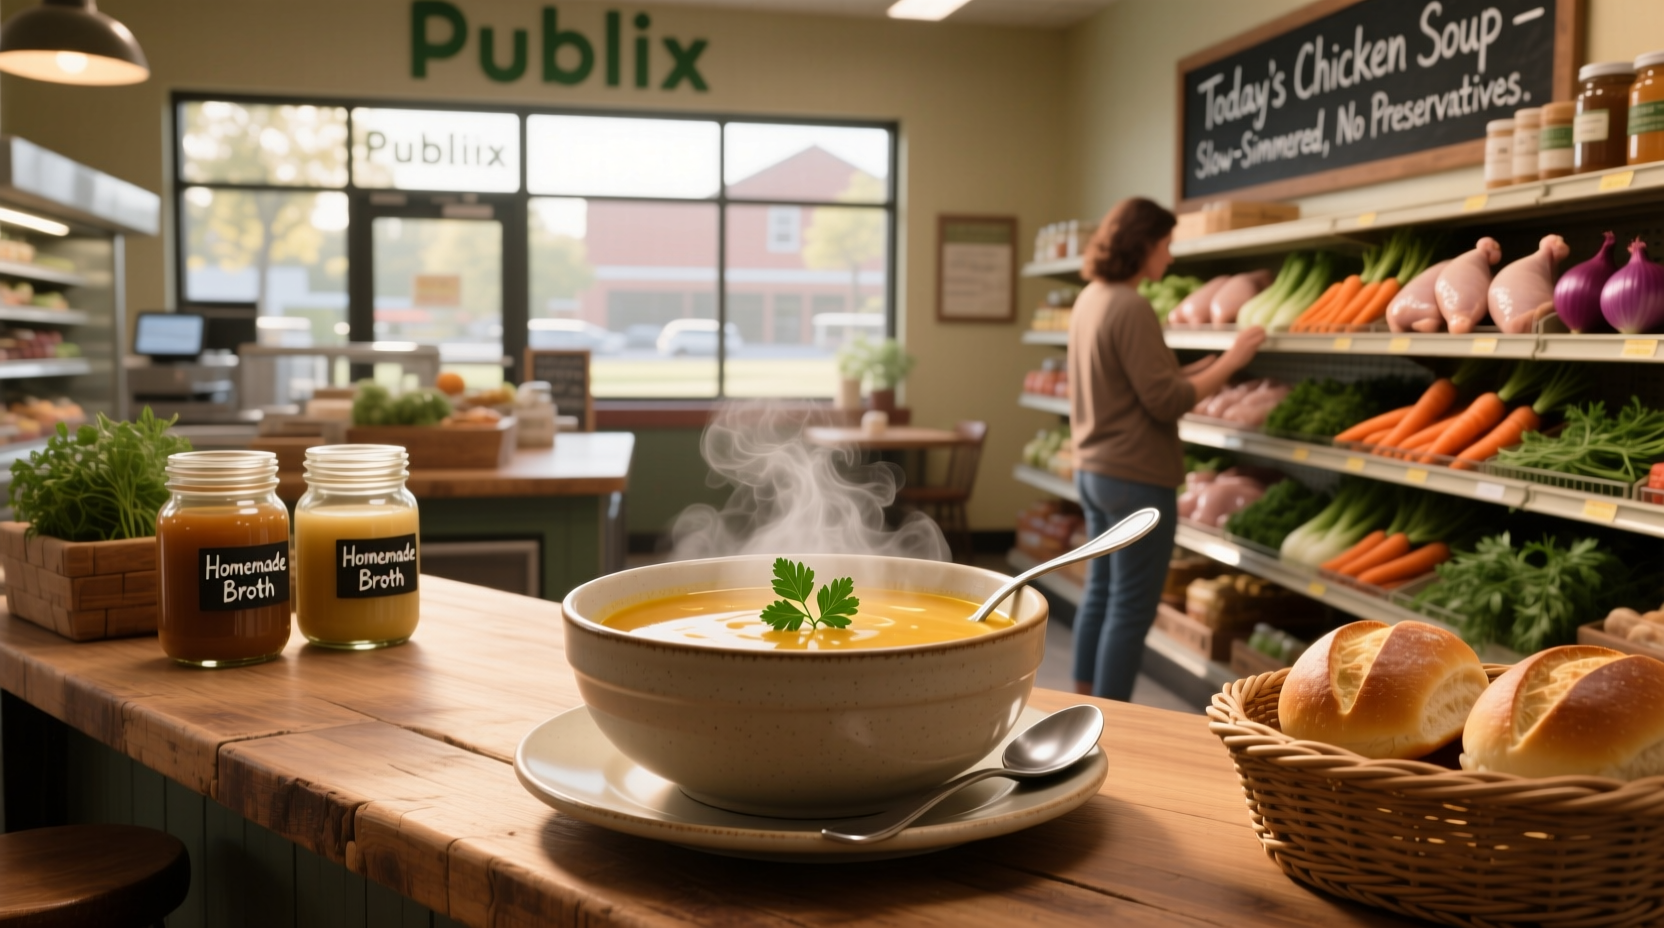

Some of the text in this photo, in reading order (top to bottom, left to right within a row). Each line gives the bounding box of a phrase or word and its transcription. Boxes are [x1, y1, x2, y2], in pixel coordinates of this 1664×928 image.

[410, 0, 710, 92] Publix
[1197, 58, 1287, 131] Today's
[1294, 24, 1406, 100] Chicken
[1416, 1, 1503, 74] Soup
[1335, 100, 1365, 146] No
[1370, 71, 1531, 139] Preservatives.
[205, 550, 287, 580] Homemade
[342, 541, 416, 568] Homemade
[223, 575, 275, 603] Broth
[359, 566, 405, 591] Broth
